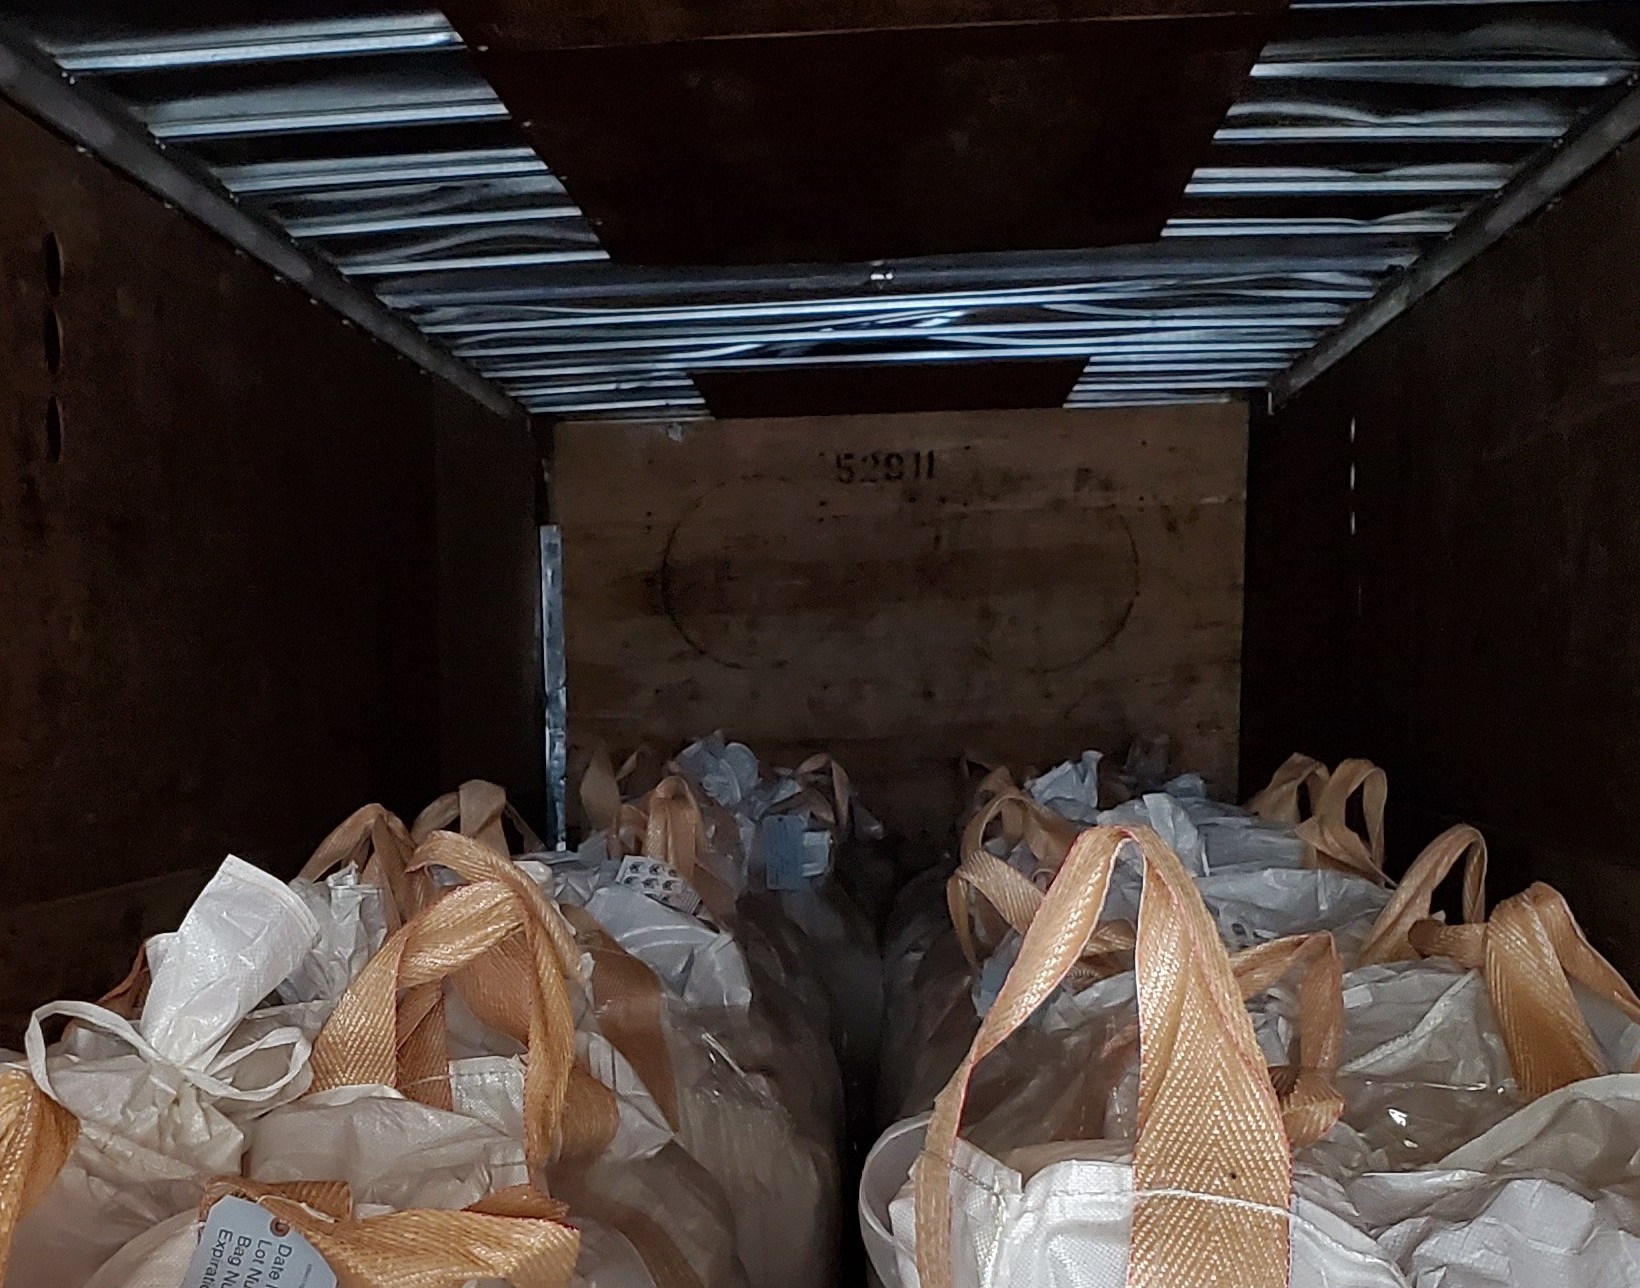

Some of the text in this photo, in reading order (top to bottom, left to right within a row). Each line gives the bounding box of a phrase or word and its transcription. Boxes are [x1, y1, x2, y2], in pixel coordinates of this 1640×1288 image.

[227, 1235, 252, 1267] Bag
[252, 1239, 272, 1265] Lot
[269, 1244, 293, 1280] Date
